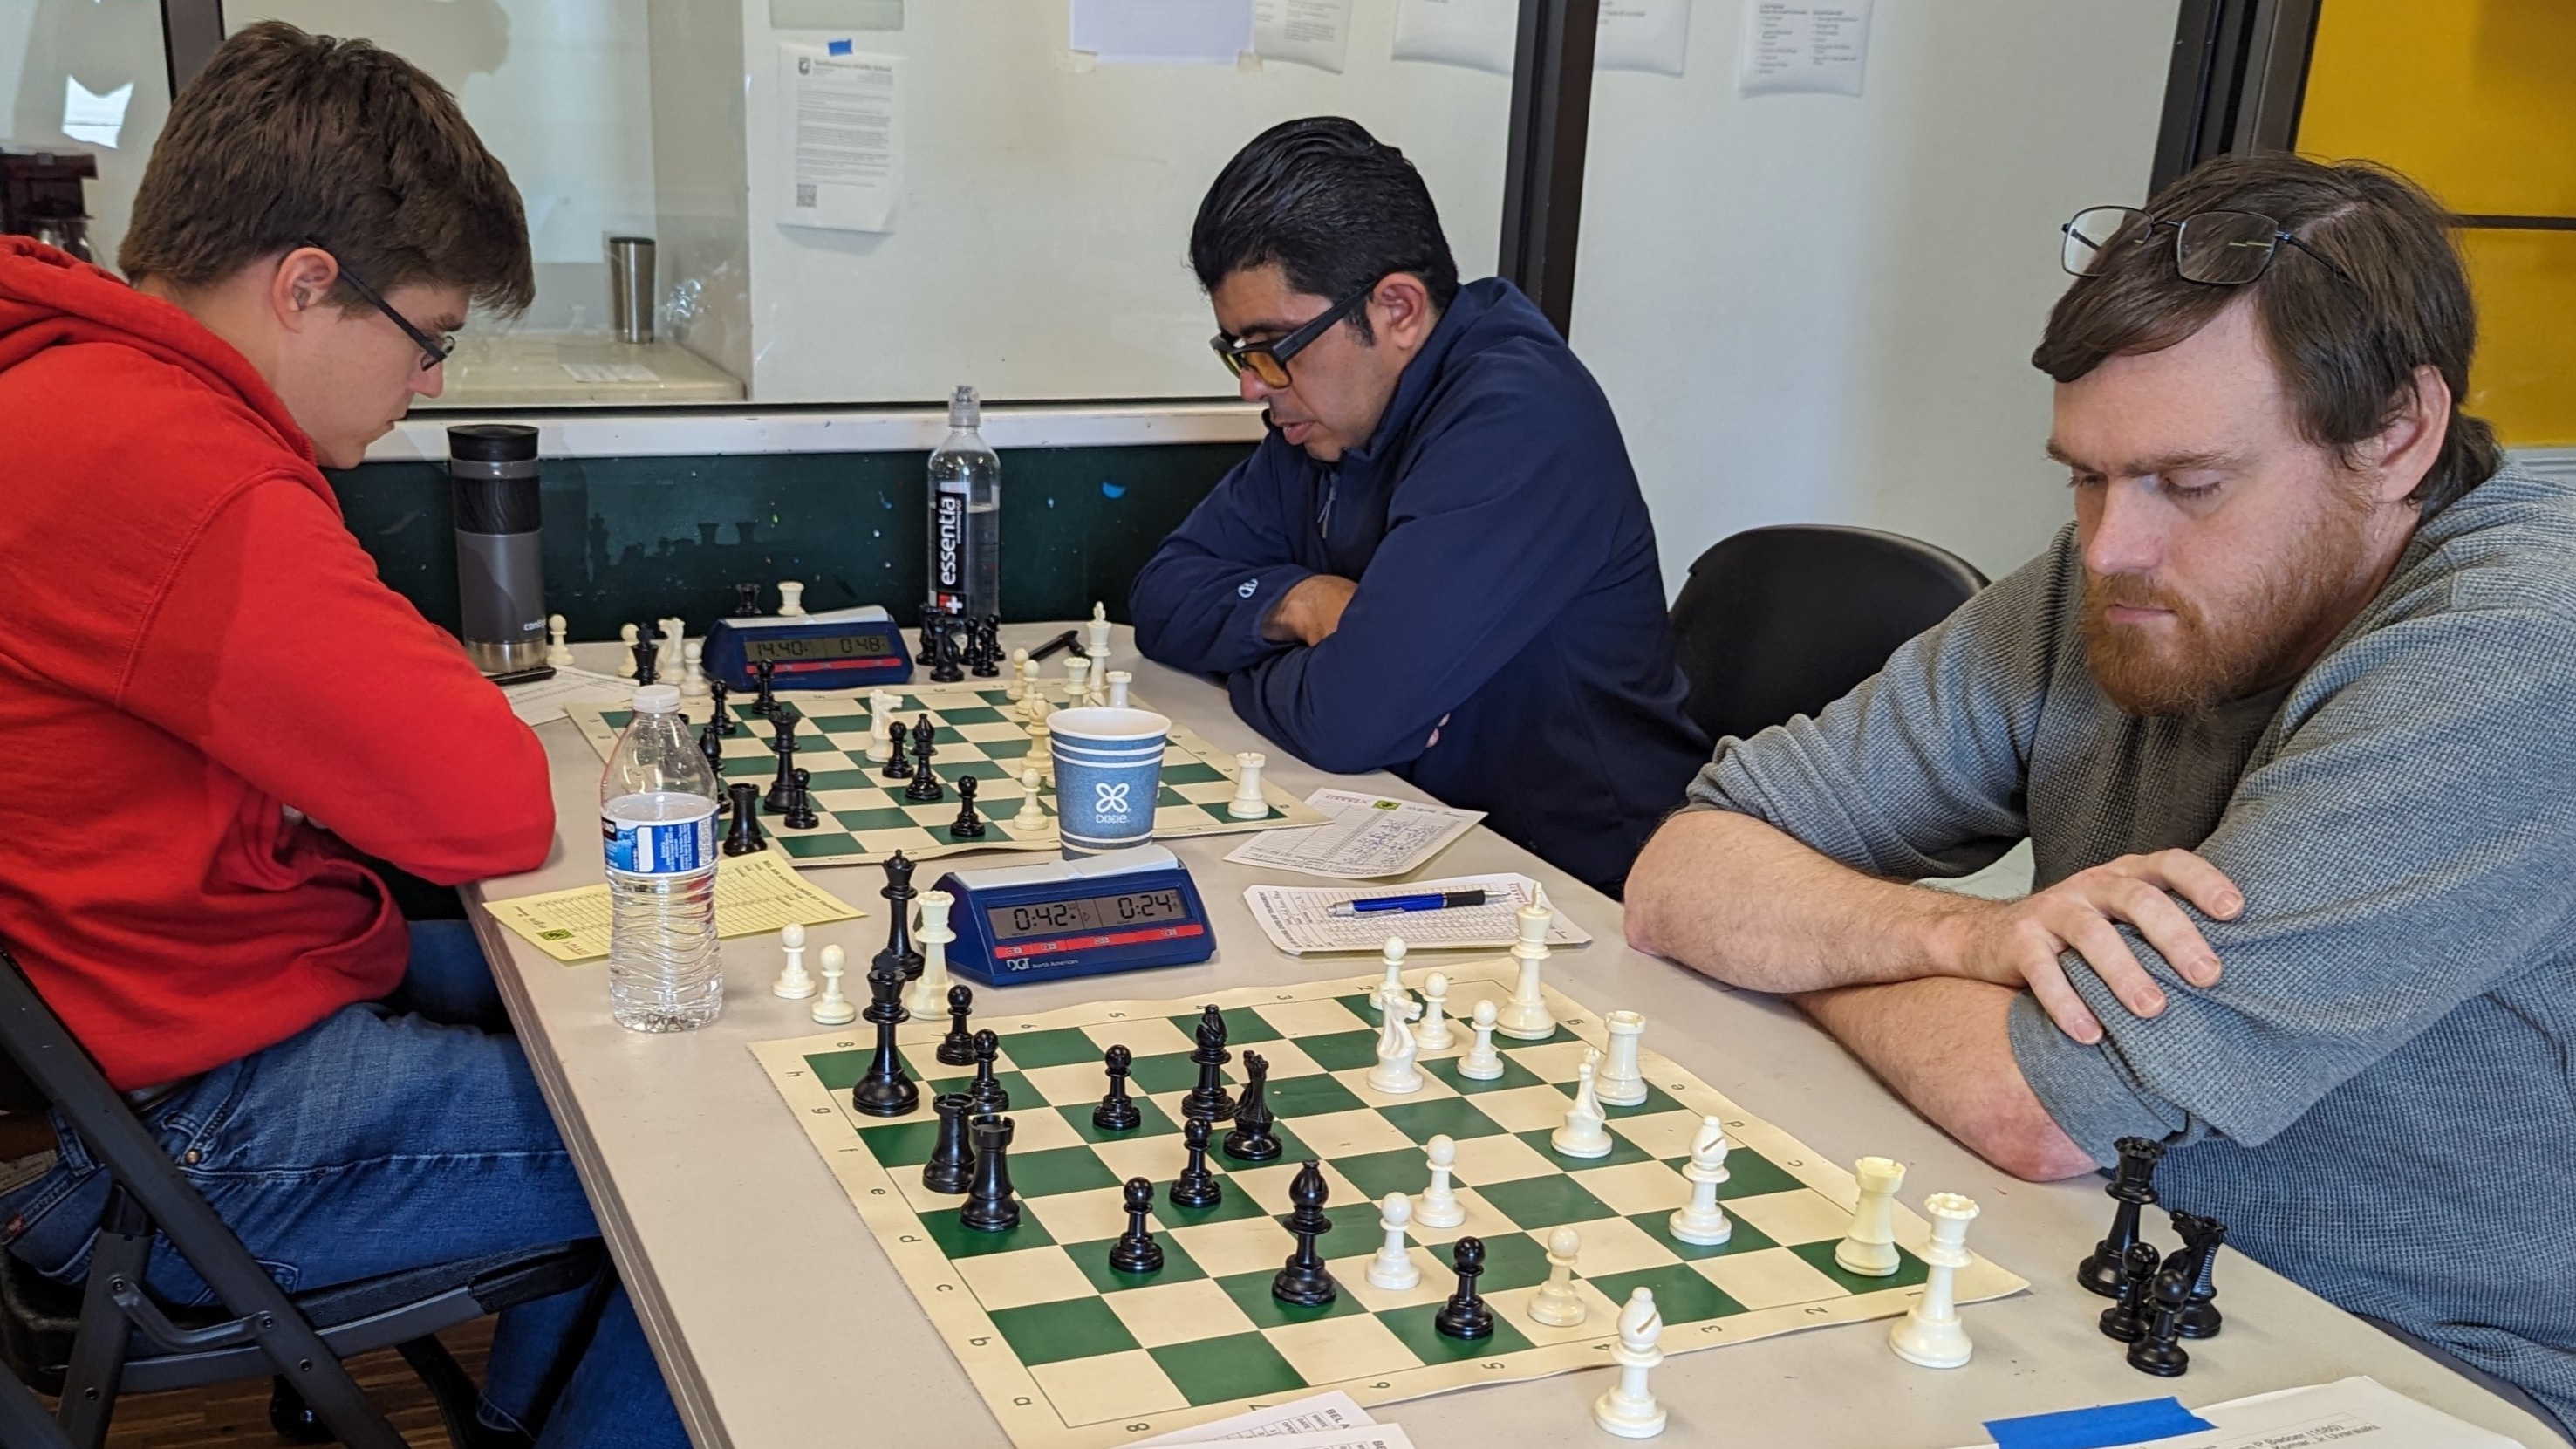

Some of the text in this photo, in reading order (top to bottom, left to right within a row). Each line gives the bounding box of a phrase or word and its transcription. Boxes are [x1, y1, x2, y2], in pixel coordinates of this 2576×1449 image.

[939, 496, 956, 585] essentia
[1118, 894, 1172, 919] 0:24
[1014, 904, 1068, 931] 0:42
[1006, 958, 1030, 971] DGT
[899, 1234, 922, 1244] d
[936, 1283, 953, 1292] c
[1804, 1306, 1829, 1316] 2
[1701, 1324, 1723, 1334] 3
[968, 1336, 991, 1347] b
[1481, 1362, 1506, 1370] 5
[1013, 1396, 1032, 1406] a
[1312, 1414, 1329, 1427] WHITE
[1325, 1408, 1343, 1423] BEL
[1125, 1423, 1150, 1432] 8
[1297, 1418, 1311, 1429] DATE
